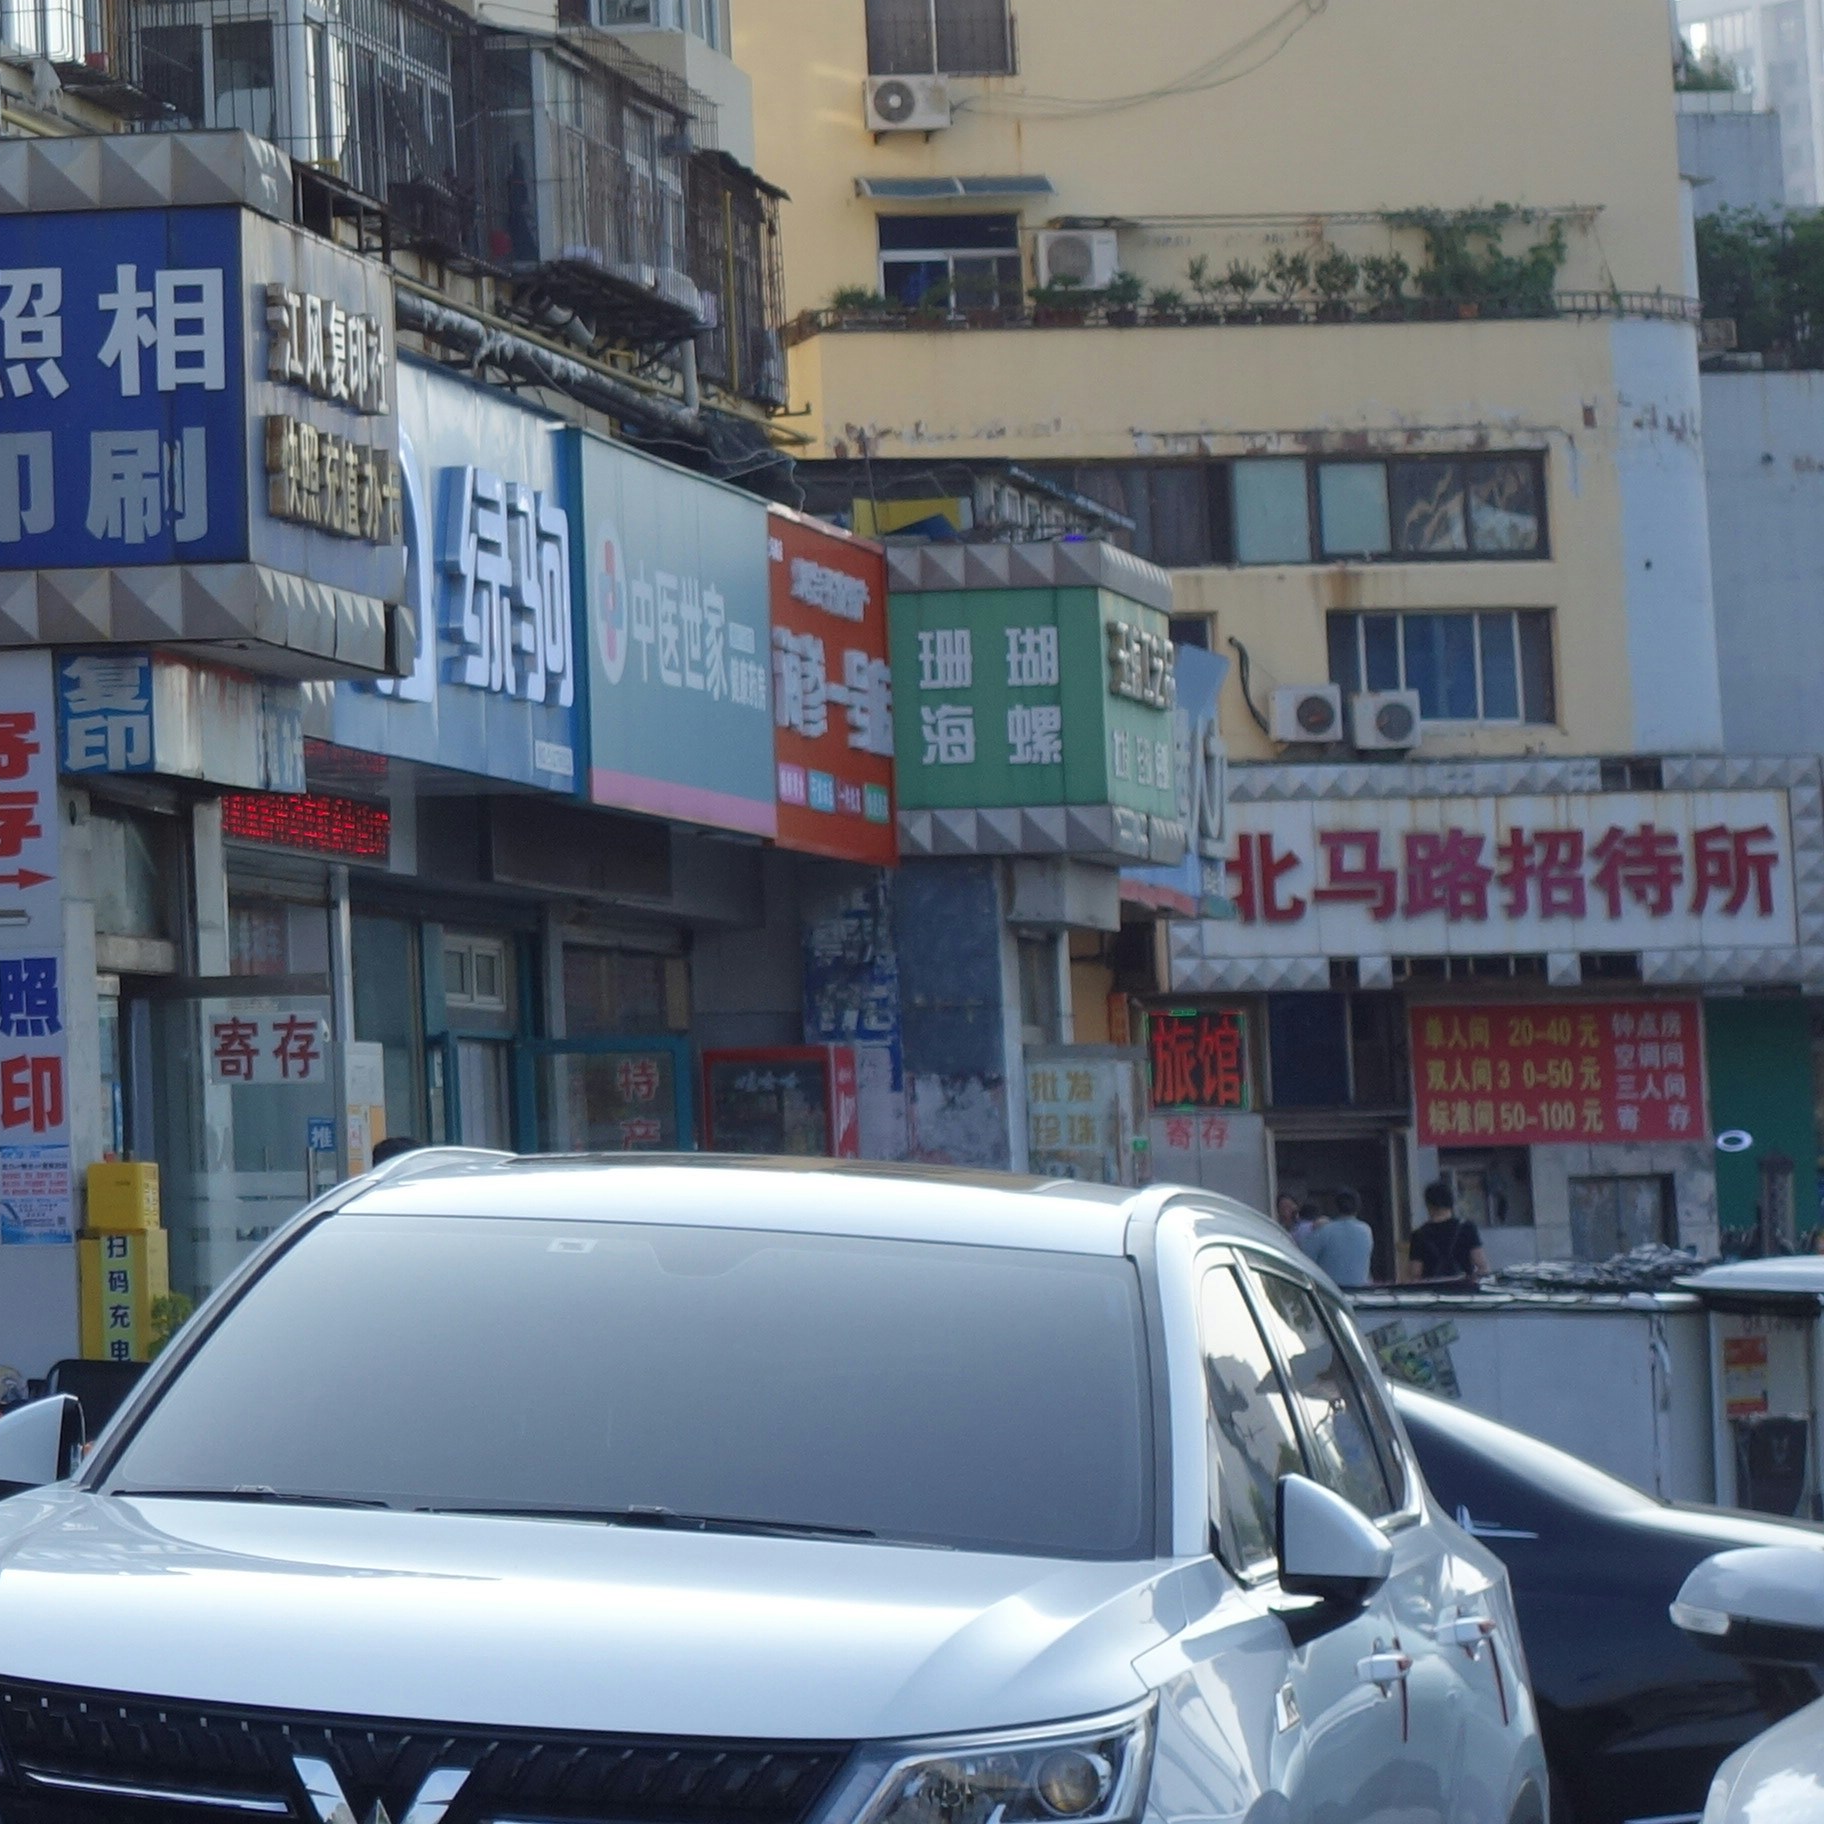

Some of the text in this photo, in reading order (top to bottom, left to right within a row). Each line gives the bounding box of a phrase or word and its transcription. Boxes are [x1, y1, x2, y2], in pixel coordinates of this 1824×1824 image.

[628, 560, 728, 702] 中医世家
[918, 626, 1060, 690] 珊瑚
[62, 656, 153, 773] 复印
[921, 704, 1063, 765] 海螺
[1224, 821, 1781, 924] 北马路招待所
[213, 1013, 321, 1080] 寄存
[1153, 1023, 1243, 1106] 旅馆
[311, 1126, 334, 1151] 推
[106, 1234, 133, 1363] 扫码充电
